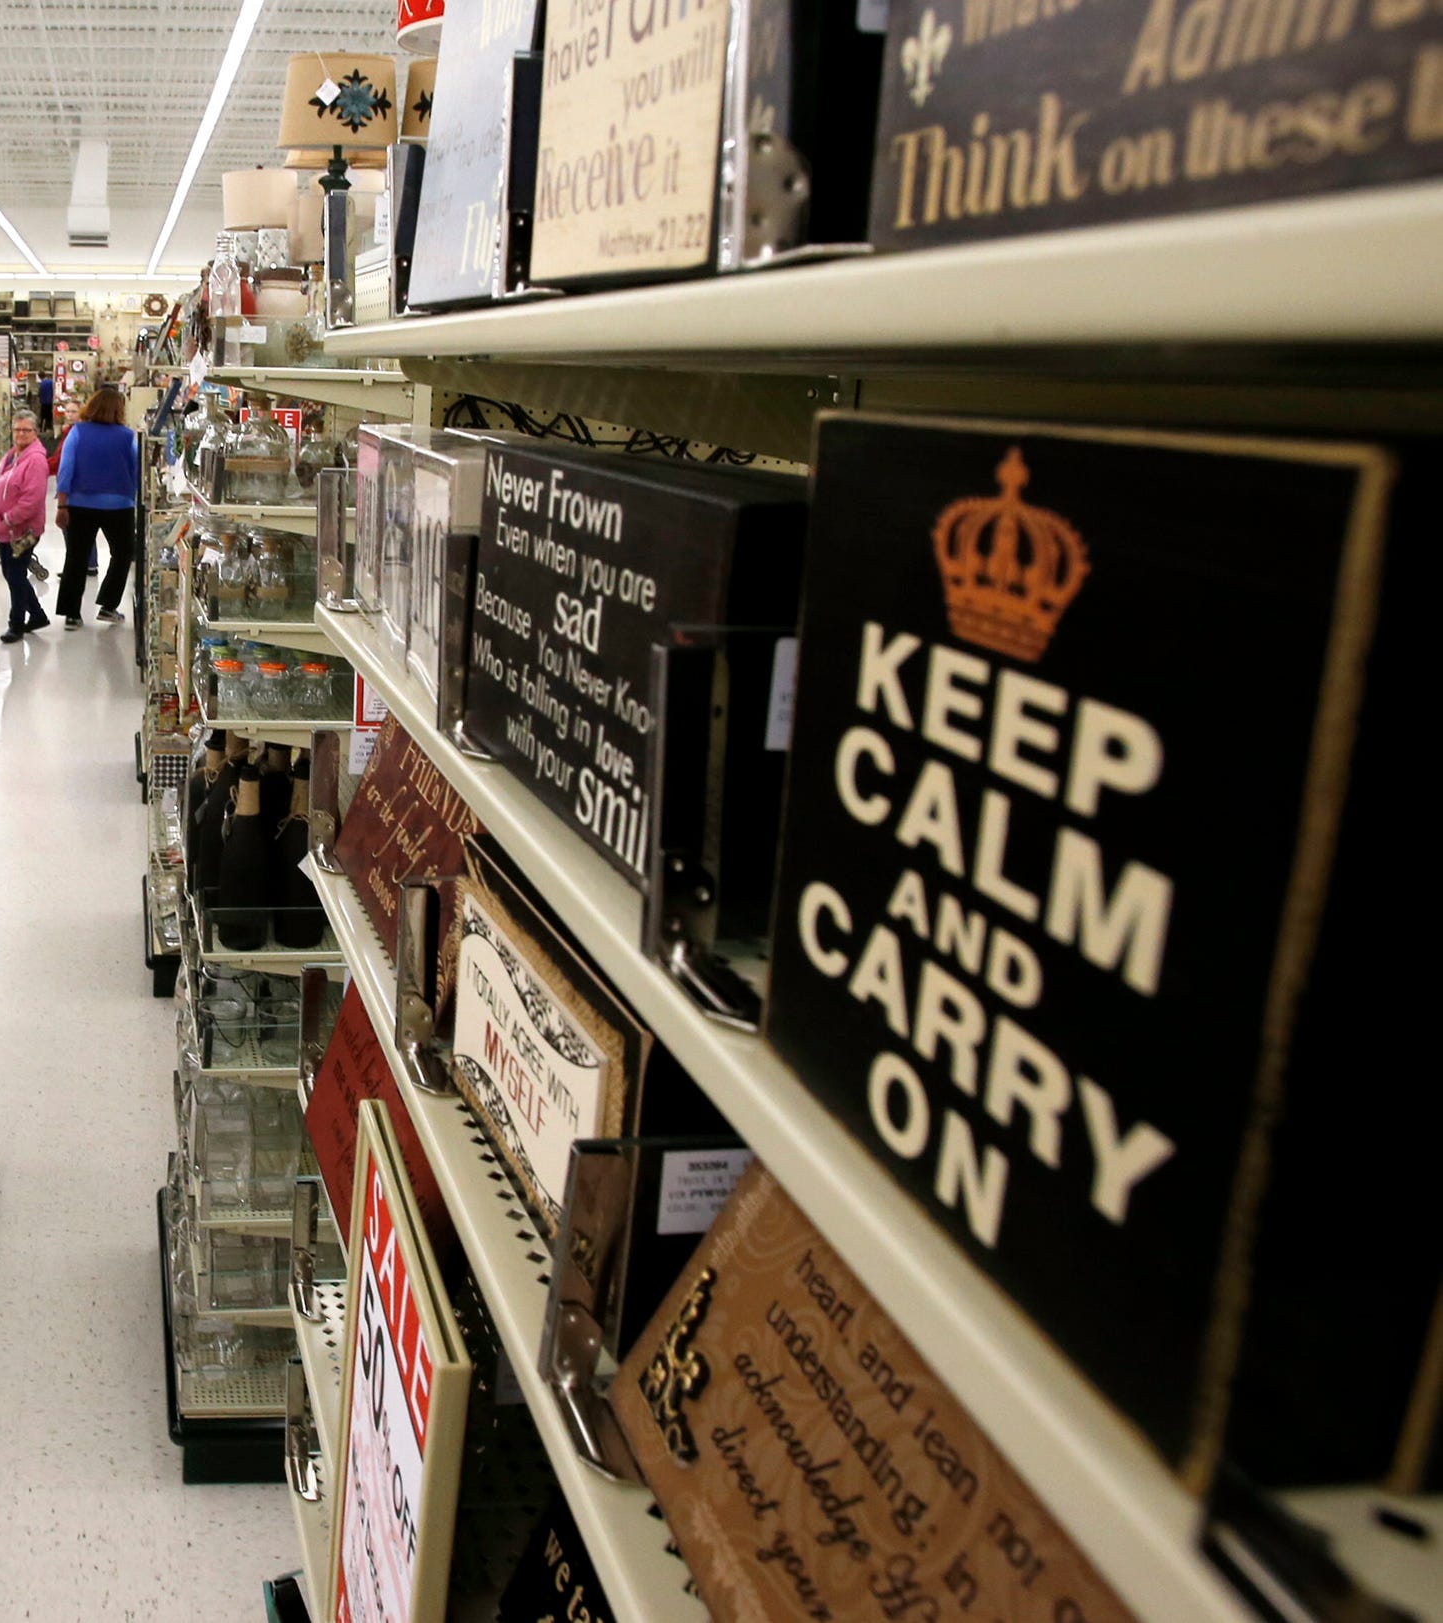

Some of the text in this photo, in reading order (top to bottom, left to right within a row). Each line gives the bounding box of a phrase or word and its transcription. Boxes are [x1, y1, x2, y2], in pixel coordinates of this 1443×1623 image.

[623, 64, 664, 129] you
[669, 23, 718, 95] will
[538, 123, 655, 222] Receive
[662, 137, 680, 195] it
[893, 92, 1094, 230] Think
[1100, 127, 1174, 195] on
[1185, 78, 1399, 182] these
[657, 211, 706, 252] 21:22
[486, 455, 623, 543] Never Frown
[496, 506, 656, 613] Even when you are
[475, 573, 532, 641] Because
[537, 627, 564, 677] You
[566, 653, 612, 708] Never
[614, 676, 656, 736] Kno
[552, 591, 604, 655] sad
[473, 632, 635, 788] Who is falling in love
[856, 619, 1165, 818] KEEP
[507, 714, 650, 875] with your smil
[834, 725, 1175, 998] CALM
[887, 869, 1043, 1010] AND
[472, 960, 510, 1031] TOTALLY
[511, 1019, 546, 1084] AGREE
[547, 1065, 580, 1134] WITH
[485, 1020, 549, 1137] MYSELF
[797, 881, 1177, 1226] CARRY
[867, 1051, 1009, 1250] ON
[368, 1171, 432, 1436] SALE
[392, 1464, 416, 1563] OFF
[711, 1422, 780, 1522] direct
[734, 1350, 873, 1562] acknowledge
[859, 1341, 915, 1414] and
[913, 1408, 979, 1506] lean
[985, 1507, 1046, 1588] not
